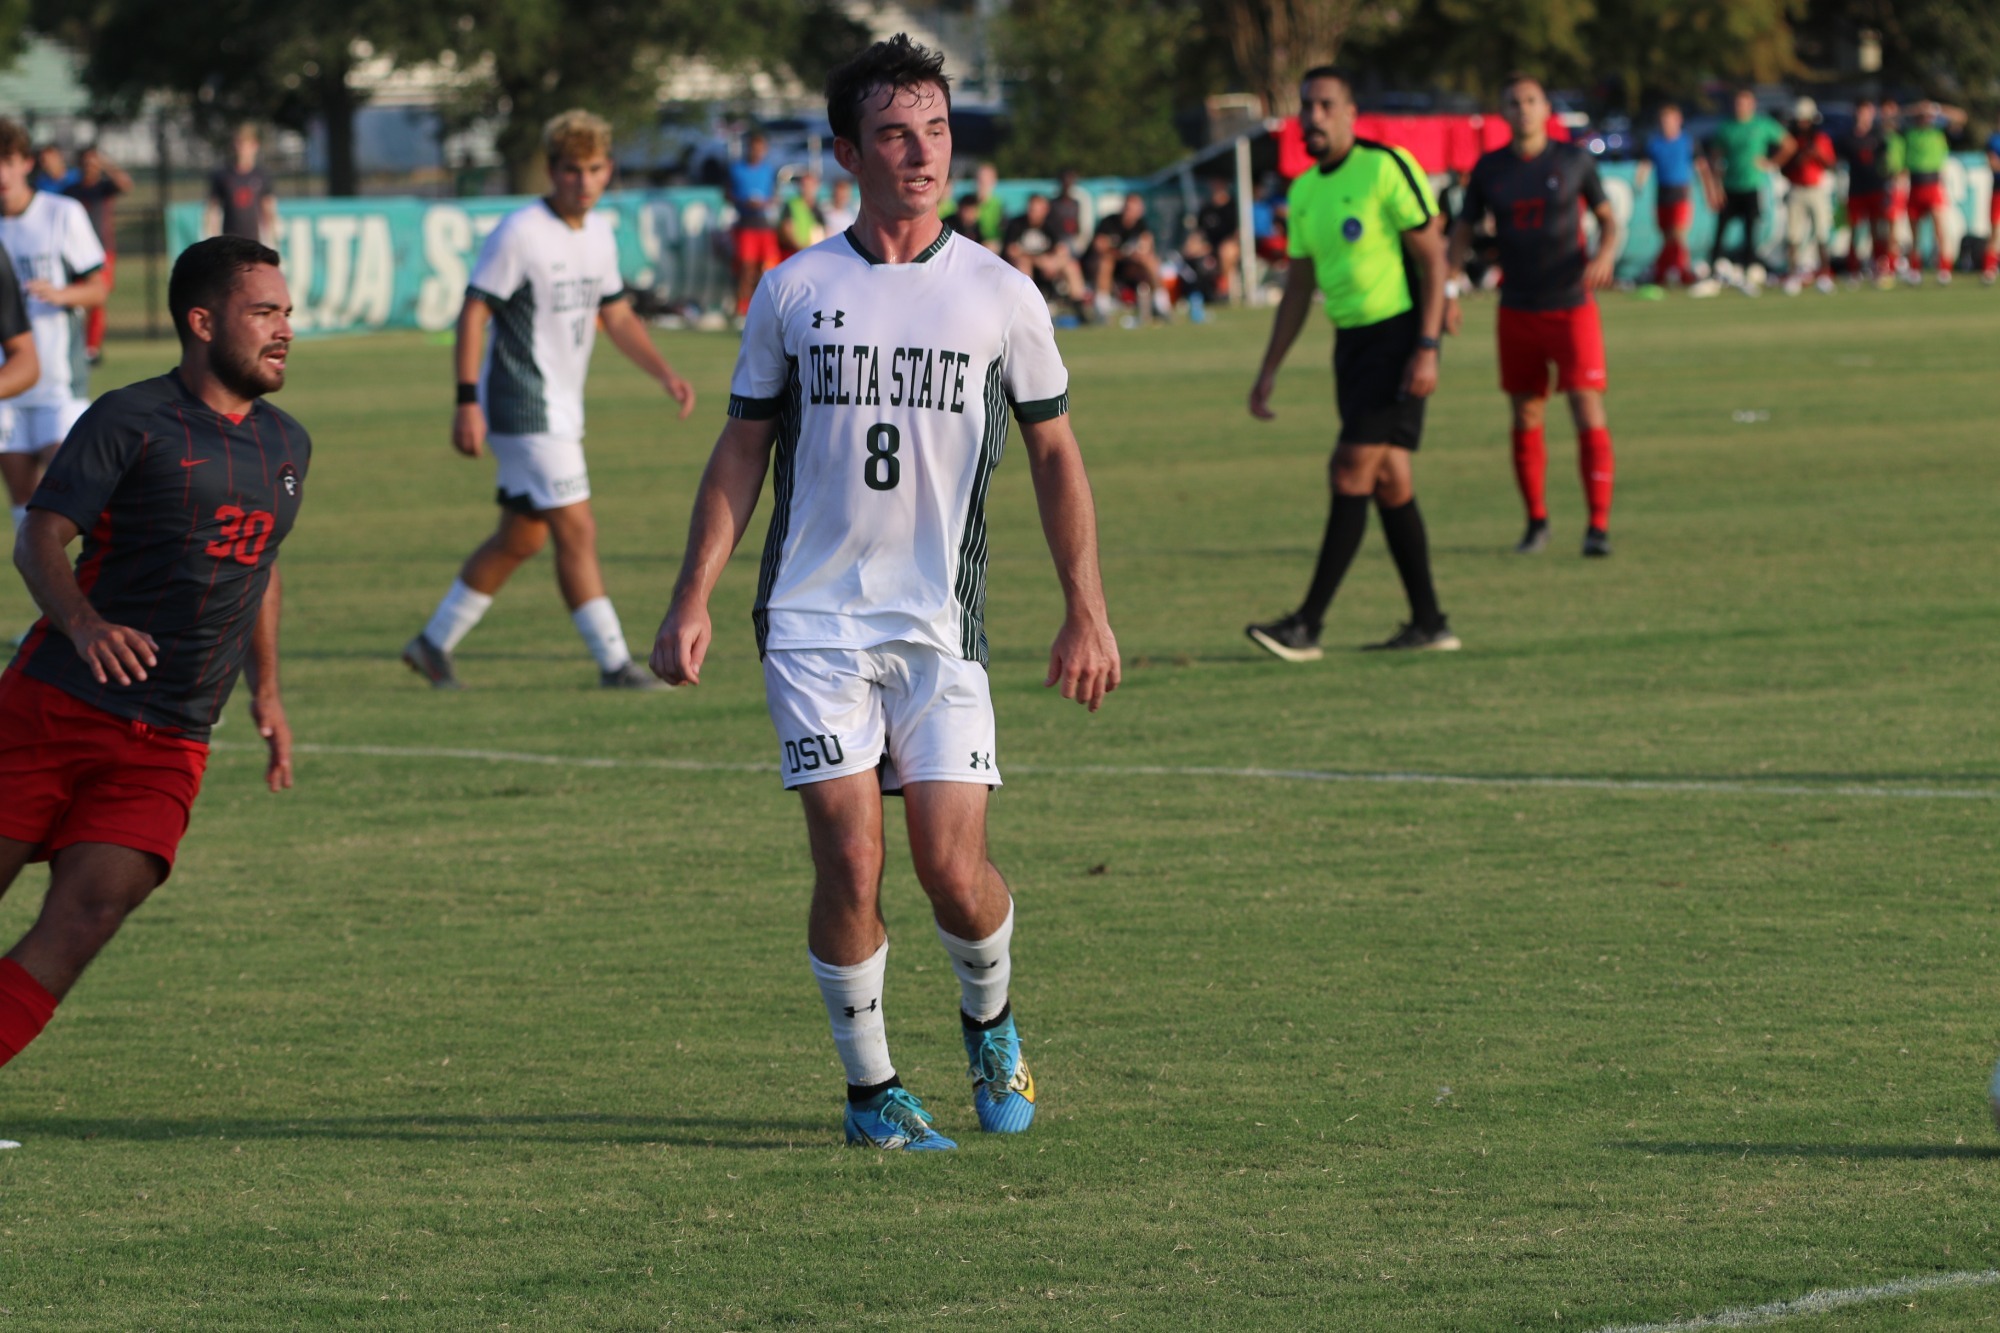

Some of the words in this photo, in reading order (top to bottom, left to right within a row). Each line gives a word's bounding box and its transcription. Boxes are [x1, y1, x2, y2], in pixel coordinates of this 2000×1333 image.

[809, 344, 880, 406] DELTA
[890, 347, 970, 414] STATE
[864, 423, 900, 491] 8
[204, 504, 275, 566] 30
[785, 734, 844, 774] DSU
